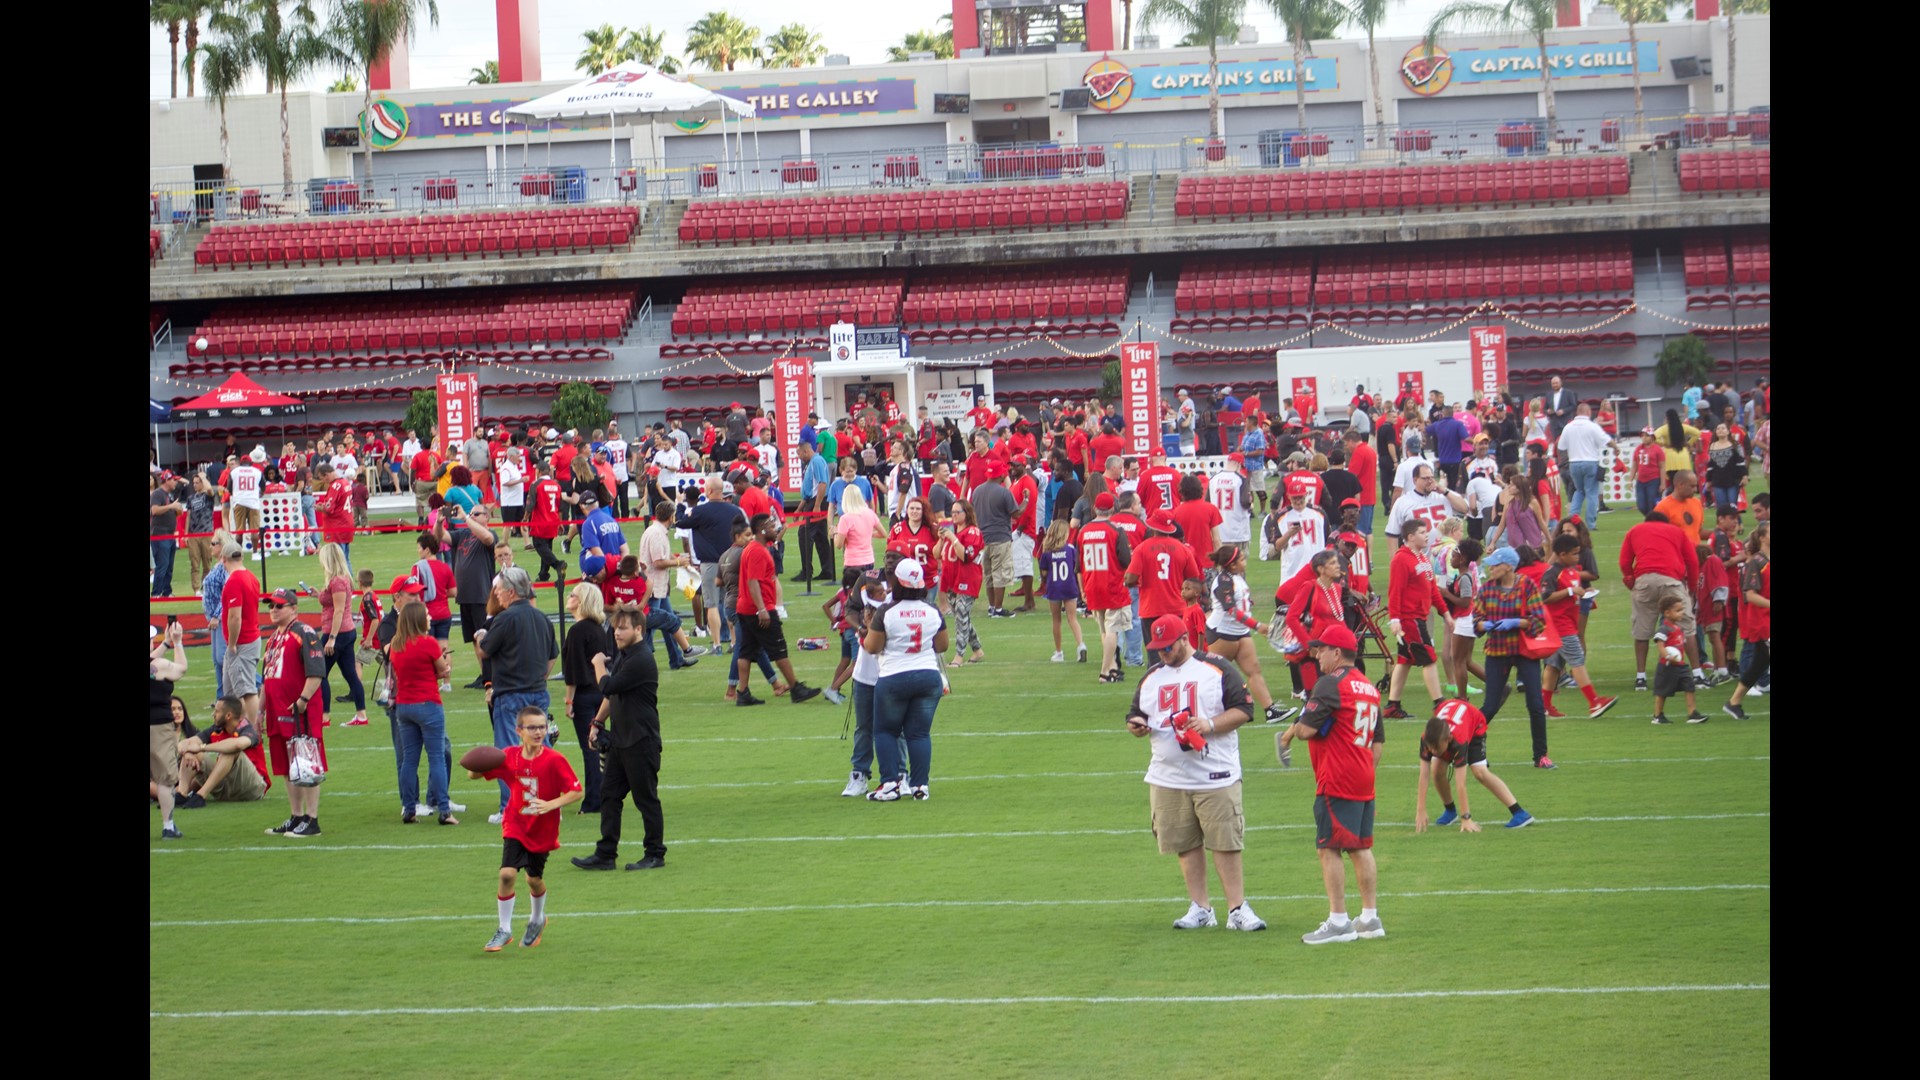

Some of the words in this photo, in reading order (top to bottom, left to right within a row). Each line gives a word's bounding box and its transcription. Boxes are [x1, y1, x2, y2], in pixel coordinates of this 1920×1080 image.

[1470, 53, 1575, 73] CAPTAIN'S
[1578, 51, 1634, 68] GRILL
[1258, 67, 1316, 84] GRIL
[746, 94, 790, 110] THE
[796, 88, 879, 108] GALLEY
[439, 111, 483, 127] THE
[833, 332, 853, 345] Lite
[857, 333, 882, 345] BAR
[884, 331, 899, 344] 75
[1480, 332, 1502, 348] Lite
[1130, 348, 1152, 363] Lite
[783, 364, 804, 379] Lite
[1481, 349, 1498, 404] ARDEN
[445, 379, 467, 395] Lite
[784, 380, 801, 445] GARDEN
[1130, 367, 1150, 455] GOBUCS
[788, 447, 803, 489] BEER
[238, 475, 256, 491] 80
[1156, 481, 1174, 511] 3
[1214, 488, 1235, 511] 13
[1412, 504, 1447, 533] 55
[1083, 543, 1108, 571] 80
[1157, 552, 1171, 580] 3
[1051, 560, 1069, 582] 10
[899, 609, 927, 618] WINSTON
[904, 623, 923, 654] 3
[1158, 681, 1198, 729] 91
[519, 776, 539, 816] 3
